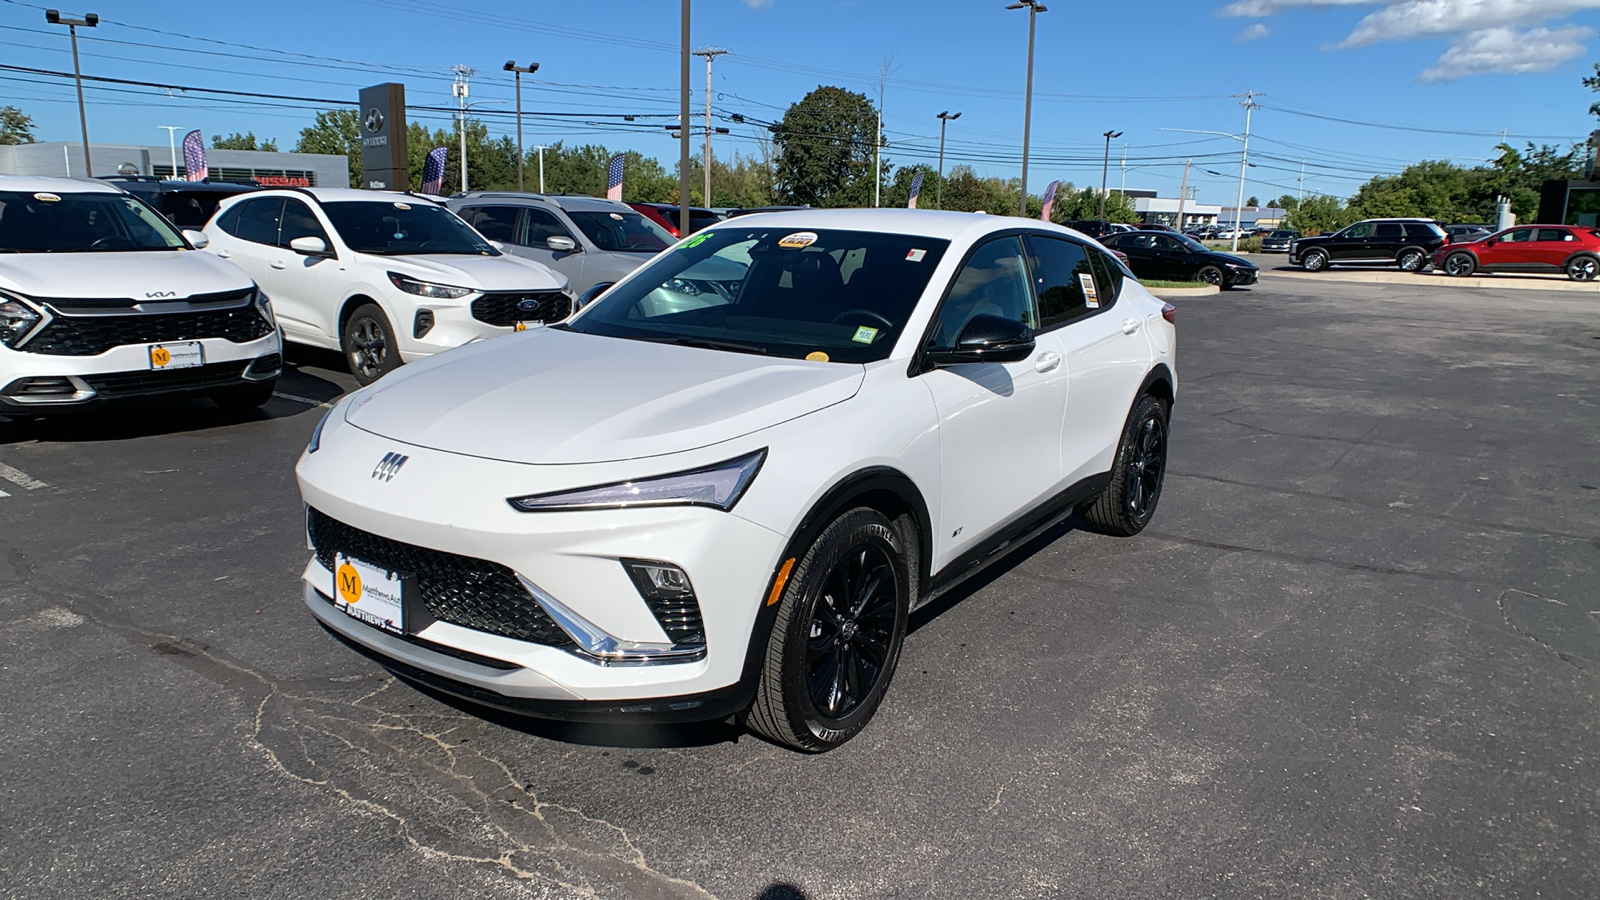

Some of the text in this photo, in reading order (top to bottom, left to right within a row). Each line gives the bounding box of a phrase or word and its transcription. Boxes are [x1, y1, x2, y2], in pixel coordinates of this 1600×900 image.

[254, 176, 309, 188] NISSAN
[155, 352, 167, 362] M
[340, 571, 358, 596] M
[362, 583, 390, 602] Matthews
[347, 606, 386, 628] MATTHEWS
